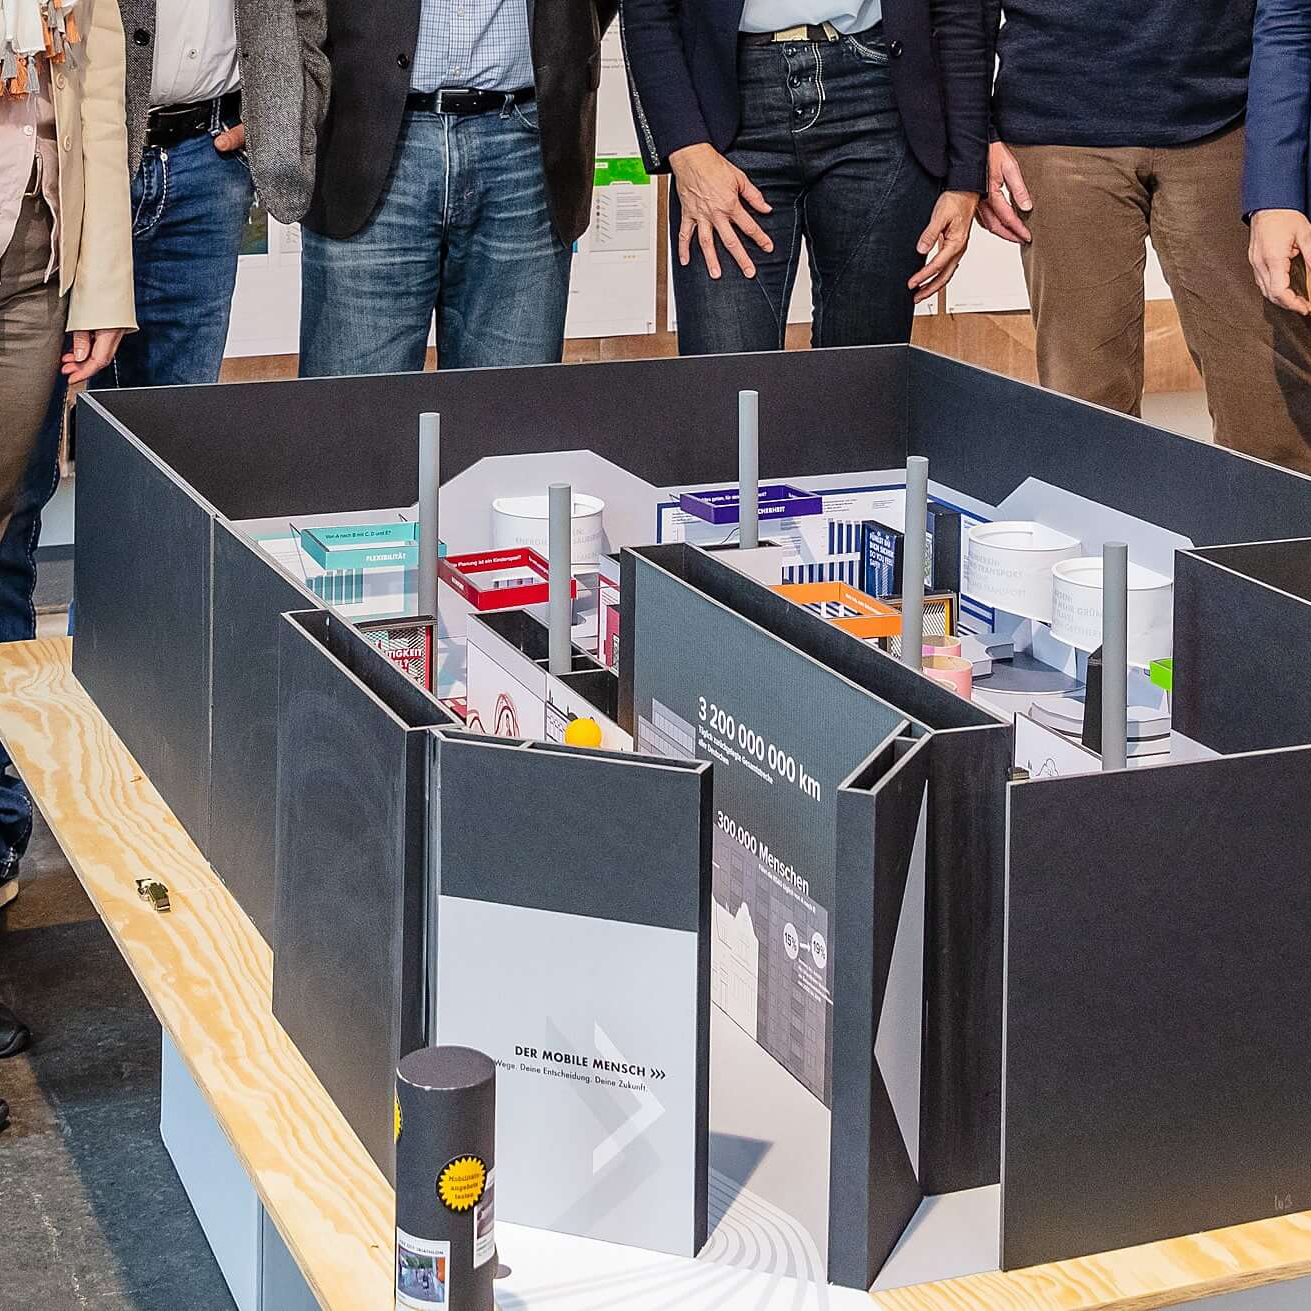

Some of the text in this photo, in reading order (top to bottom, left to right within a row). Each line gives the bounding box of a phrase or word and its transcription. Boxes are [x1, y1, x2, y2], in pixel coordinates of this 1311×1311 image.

[387, 648, 422, 660] TIGKEIT
[698, 696, 821, 802] 3 200 000 000 km
[717, 810, 810, 896] 300.000 Menschen
[784, 931, 827, 961] 15% 19%
[495, 1059, 649, 1093] Wege. Deine Entscheidung. Deine Zukunft.
[515, 1045, 646, 1077] DER MOBILE MENSCH
